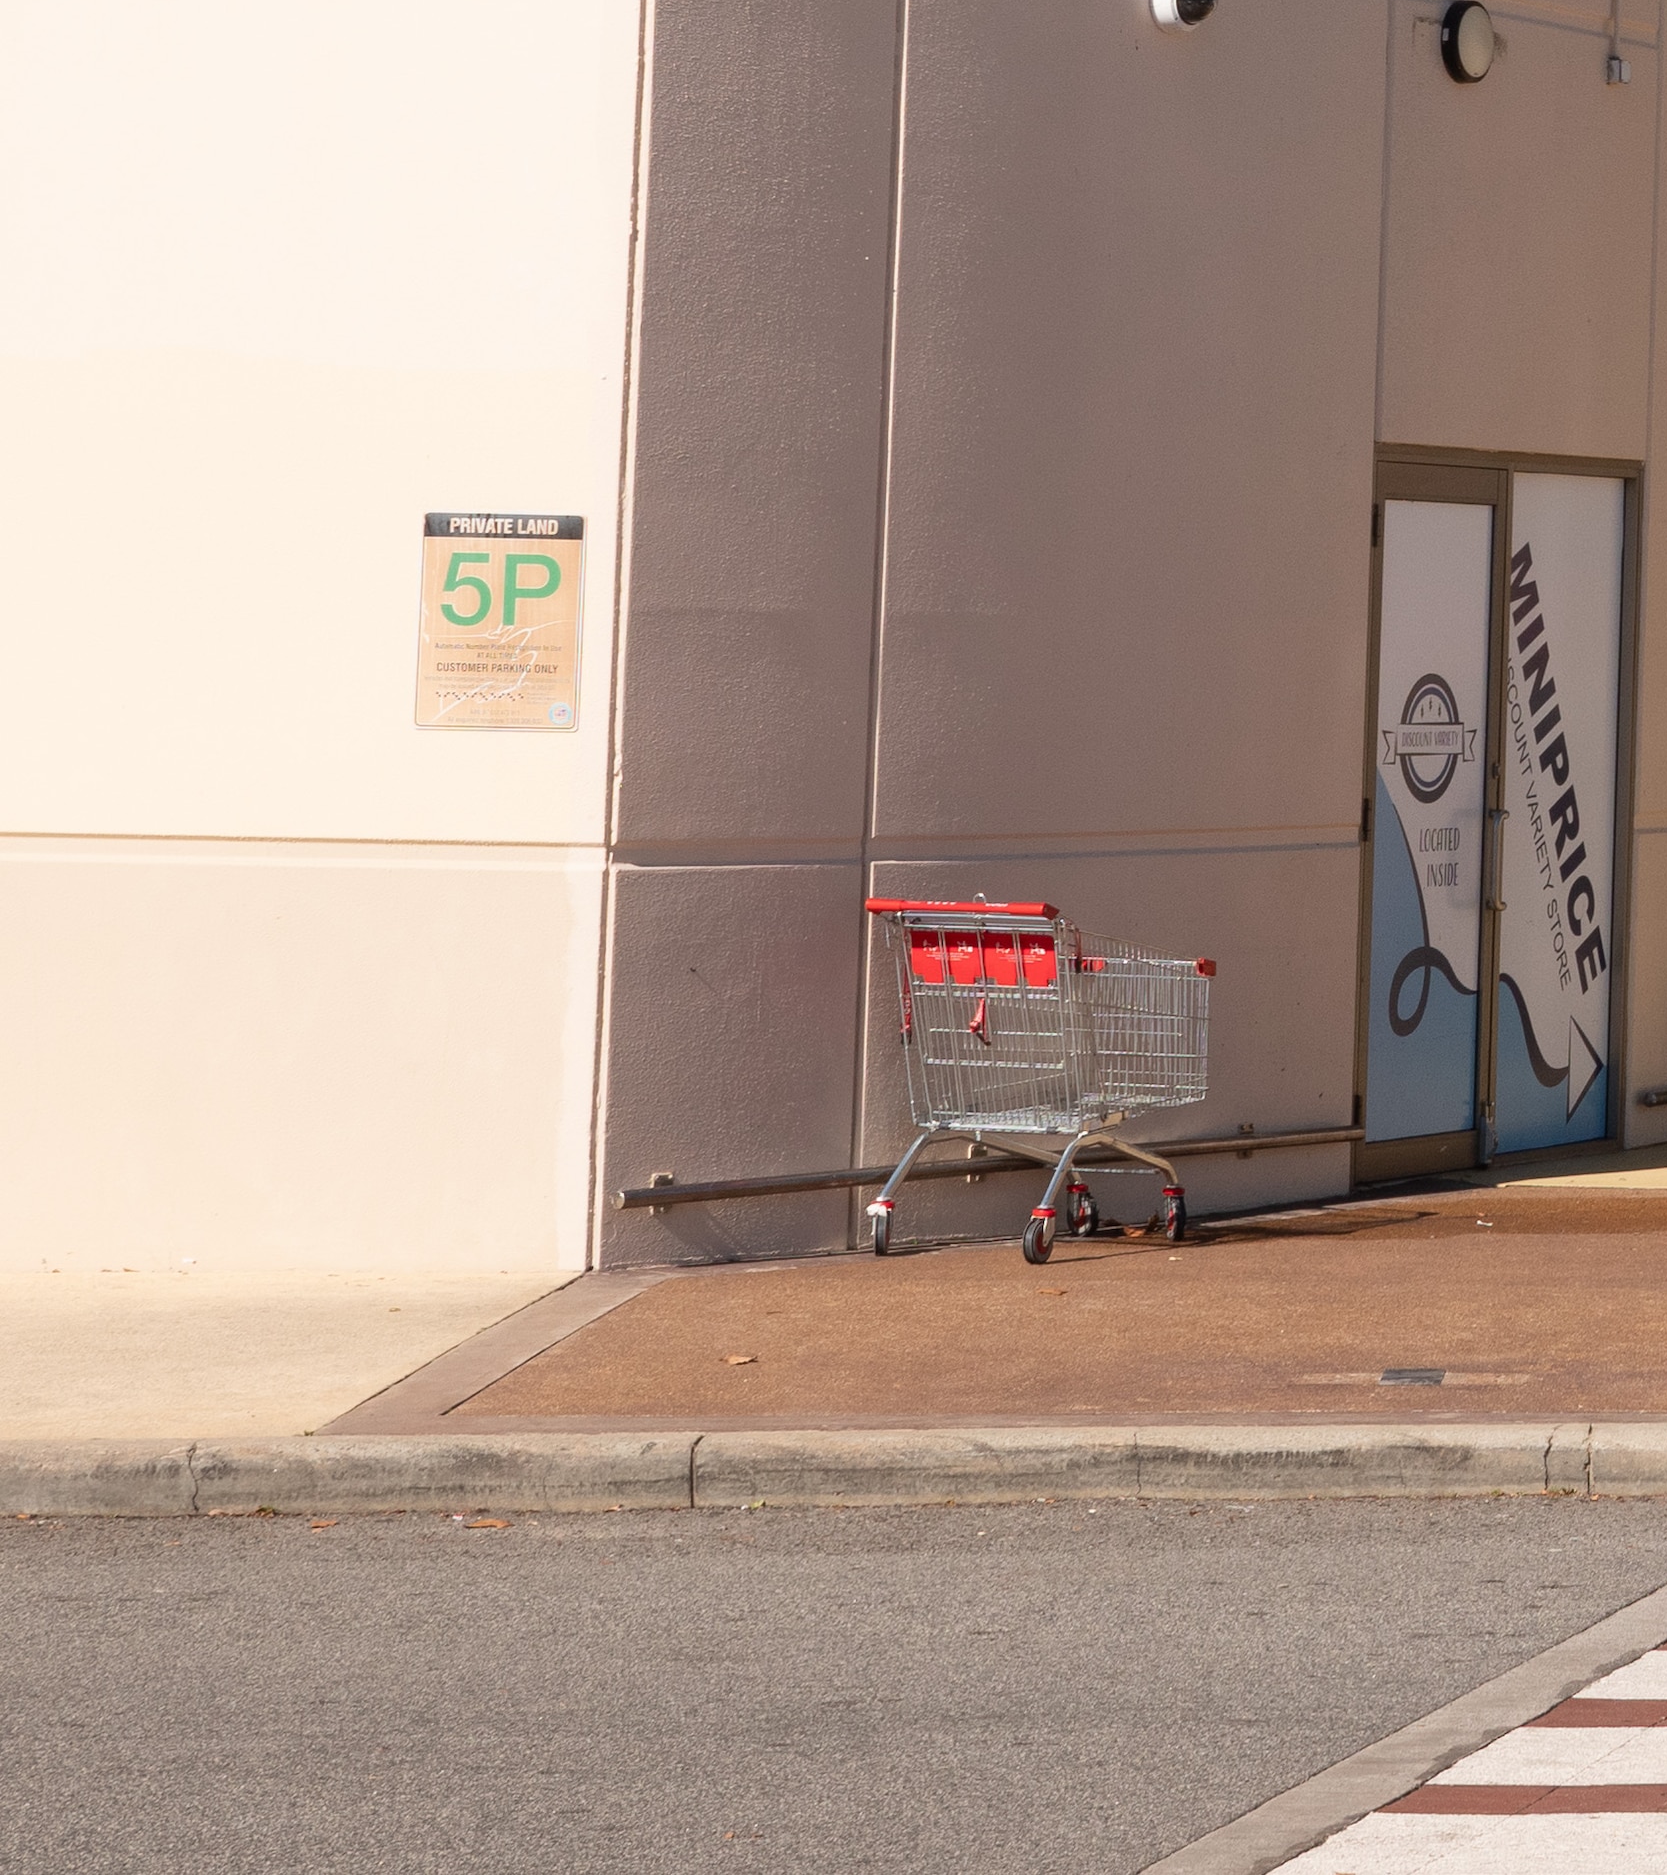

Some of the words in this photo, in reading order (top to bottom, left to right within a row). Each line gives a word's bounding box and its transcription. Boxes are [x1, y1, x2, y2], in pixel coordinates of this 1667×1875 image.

[450, 517, 513, 535] PRIVATE
[517, 519, 558, 536] LAND
[440, 552, 562, 627] 5P
[436, 662, 488, 673] CUSTOMER
[491, 663, 531, 673] PARKING
[534, 664, 559, 674] ONLY
[1402, 731, 1432, 747] DISCOUNT
[1434, 731, 1459, 747] VARIETY
[1510, 541, 1607, 995] MINIPRICE
[1419, 827, 1460, 852] LOCATED
[1427, 862, 1459, 887] INSIDE
[1525, 781, 1554, 891] VARIETY
[1547, 898, 1571, 991] STORE
